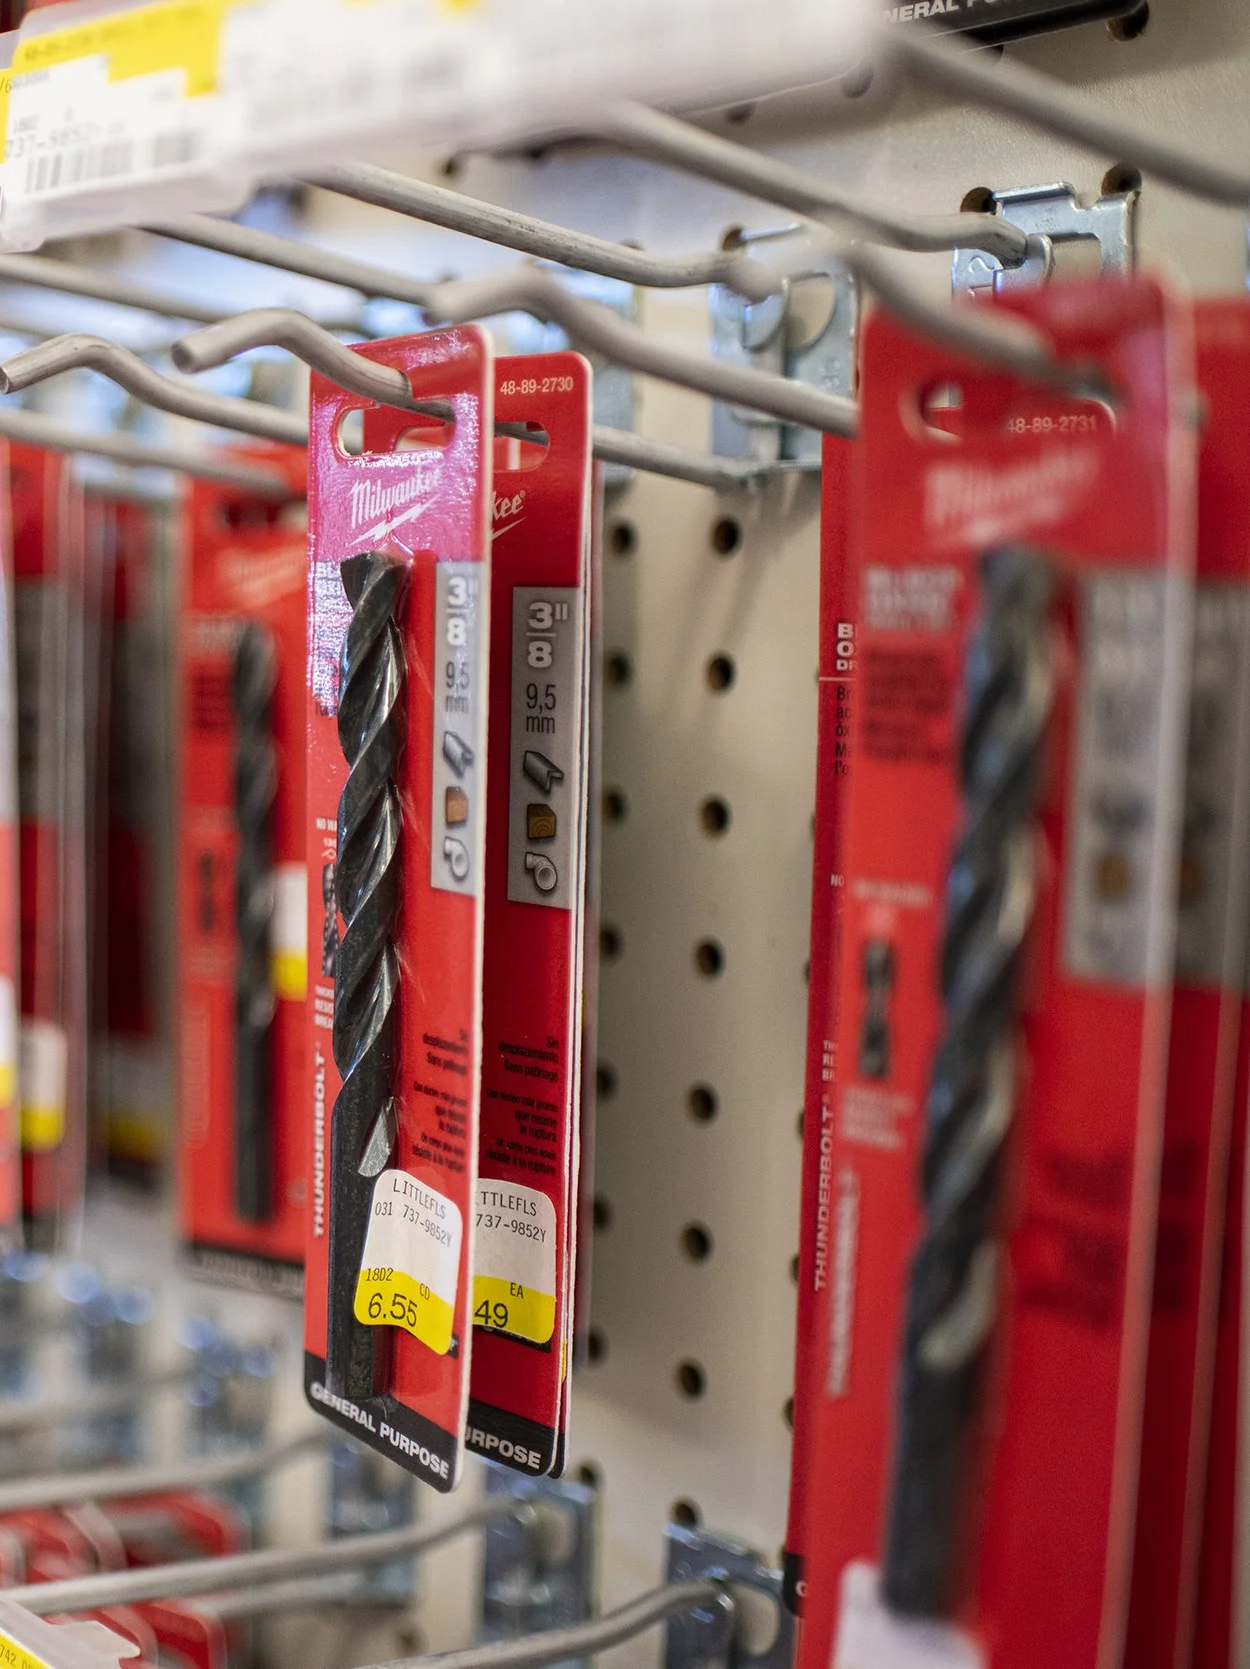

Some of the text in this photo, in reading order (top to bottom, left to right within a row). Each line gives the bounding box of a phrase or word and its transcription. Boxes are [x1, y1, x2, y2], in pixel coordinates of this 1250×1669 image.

[500, 376, 574, 396] 48-89-2730
[1005, 415, 1097, 434] 48-89-2731
[349, 466, 443, 530] Milwaukee
[446, 616, 467, 646] 8
[527, 640, 552, 668] 8
[525, 682, 557, 714] 9,5
[525, 715, 556, 735] mm
[314, 1054, 326, 1238] THUNDERBOLT
[393, 1178, 446, 1220] LITTLEFLS
[814, 1104, 833, 1293] THUNDERBOLT
[374, 1201, 453, 1248] 031 737-9852Y
[476, 1213, 547, 1243] 737-9852Y
[419, 1282, 431, 1301] CD
[510, 1281, 525, 1300] EA
[368, 1292, 418, 1328] 6.55
[310, 1381, 450, 1480] GENERAL PURPOSE
